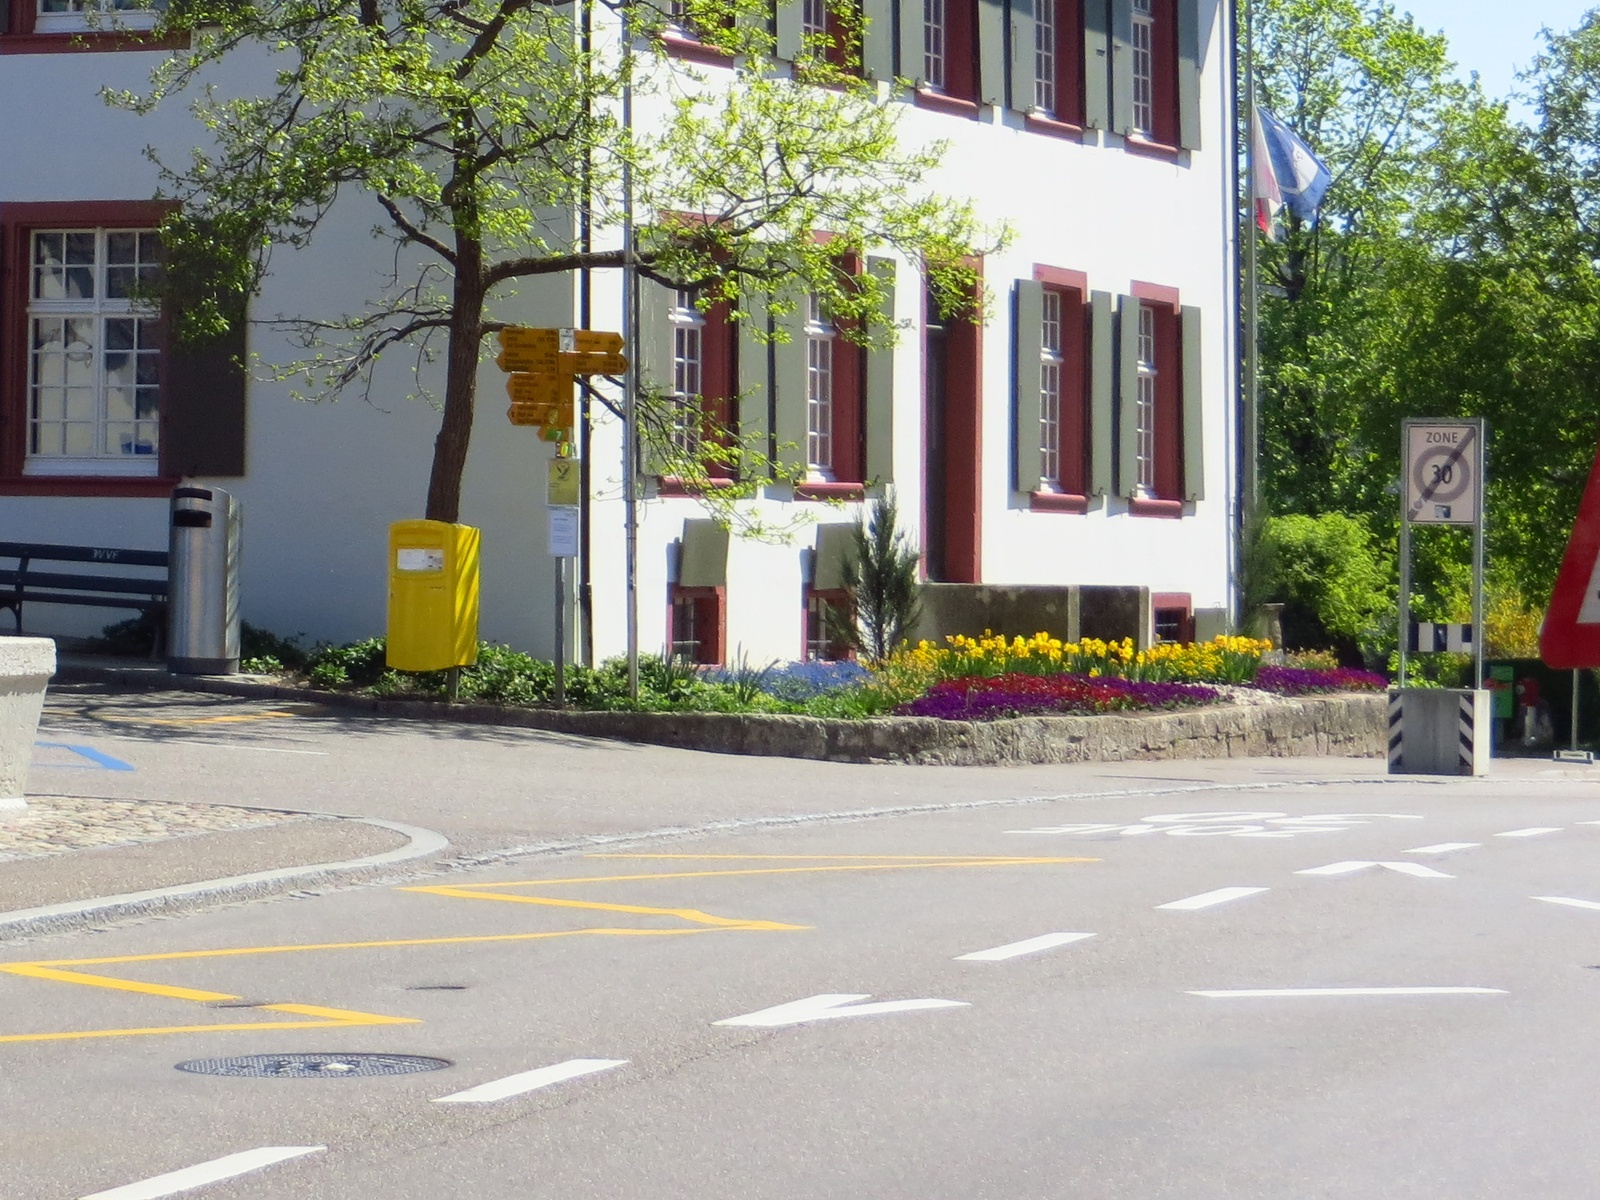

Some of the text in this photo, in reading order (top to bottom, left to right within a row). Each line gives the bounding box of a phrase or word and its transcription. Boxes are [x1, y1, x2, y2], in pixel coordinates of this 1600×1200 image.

[1426, 431, 1458, 444] ZONE
[1432, 464, 1452, 484] 30
[1002, 823, 1349, 838] ZONE
